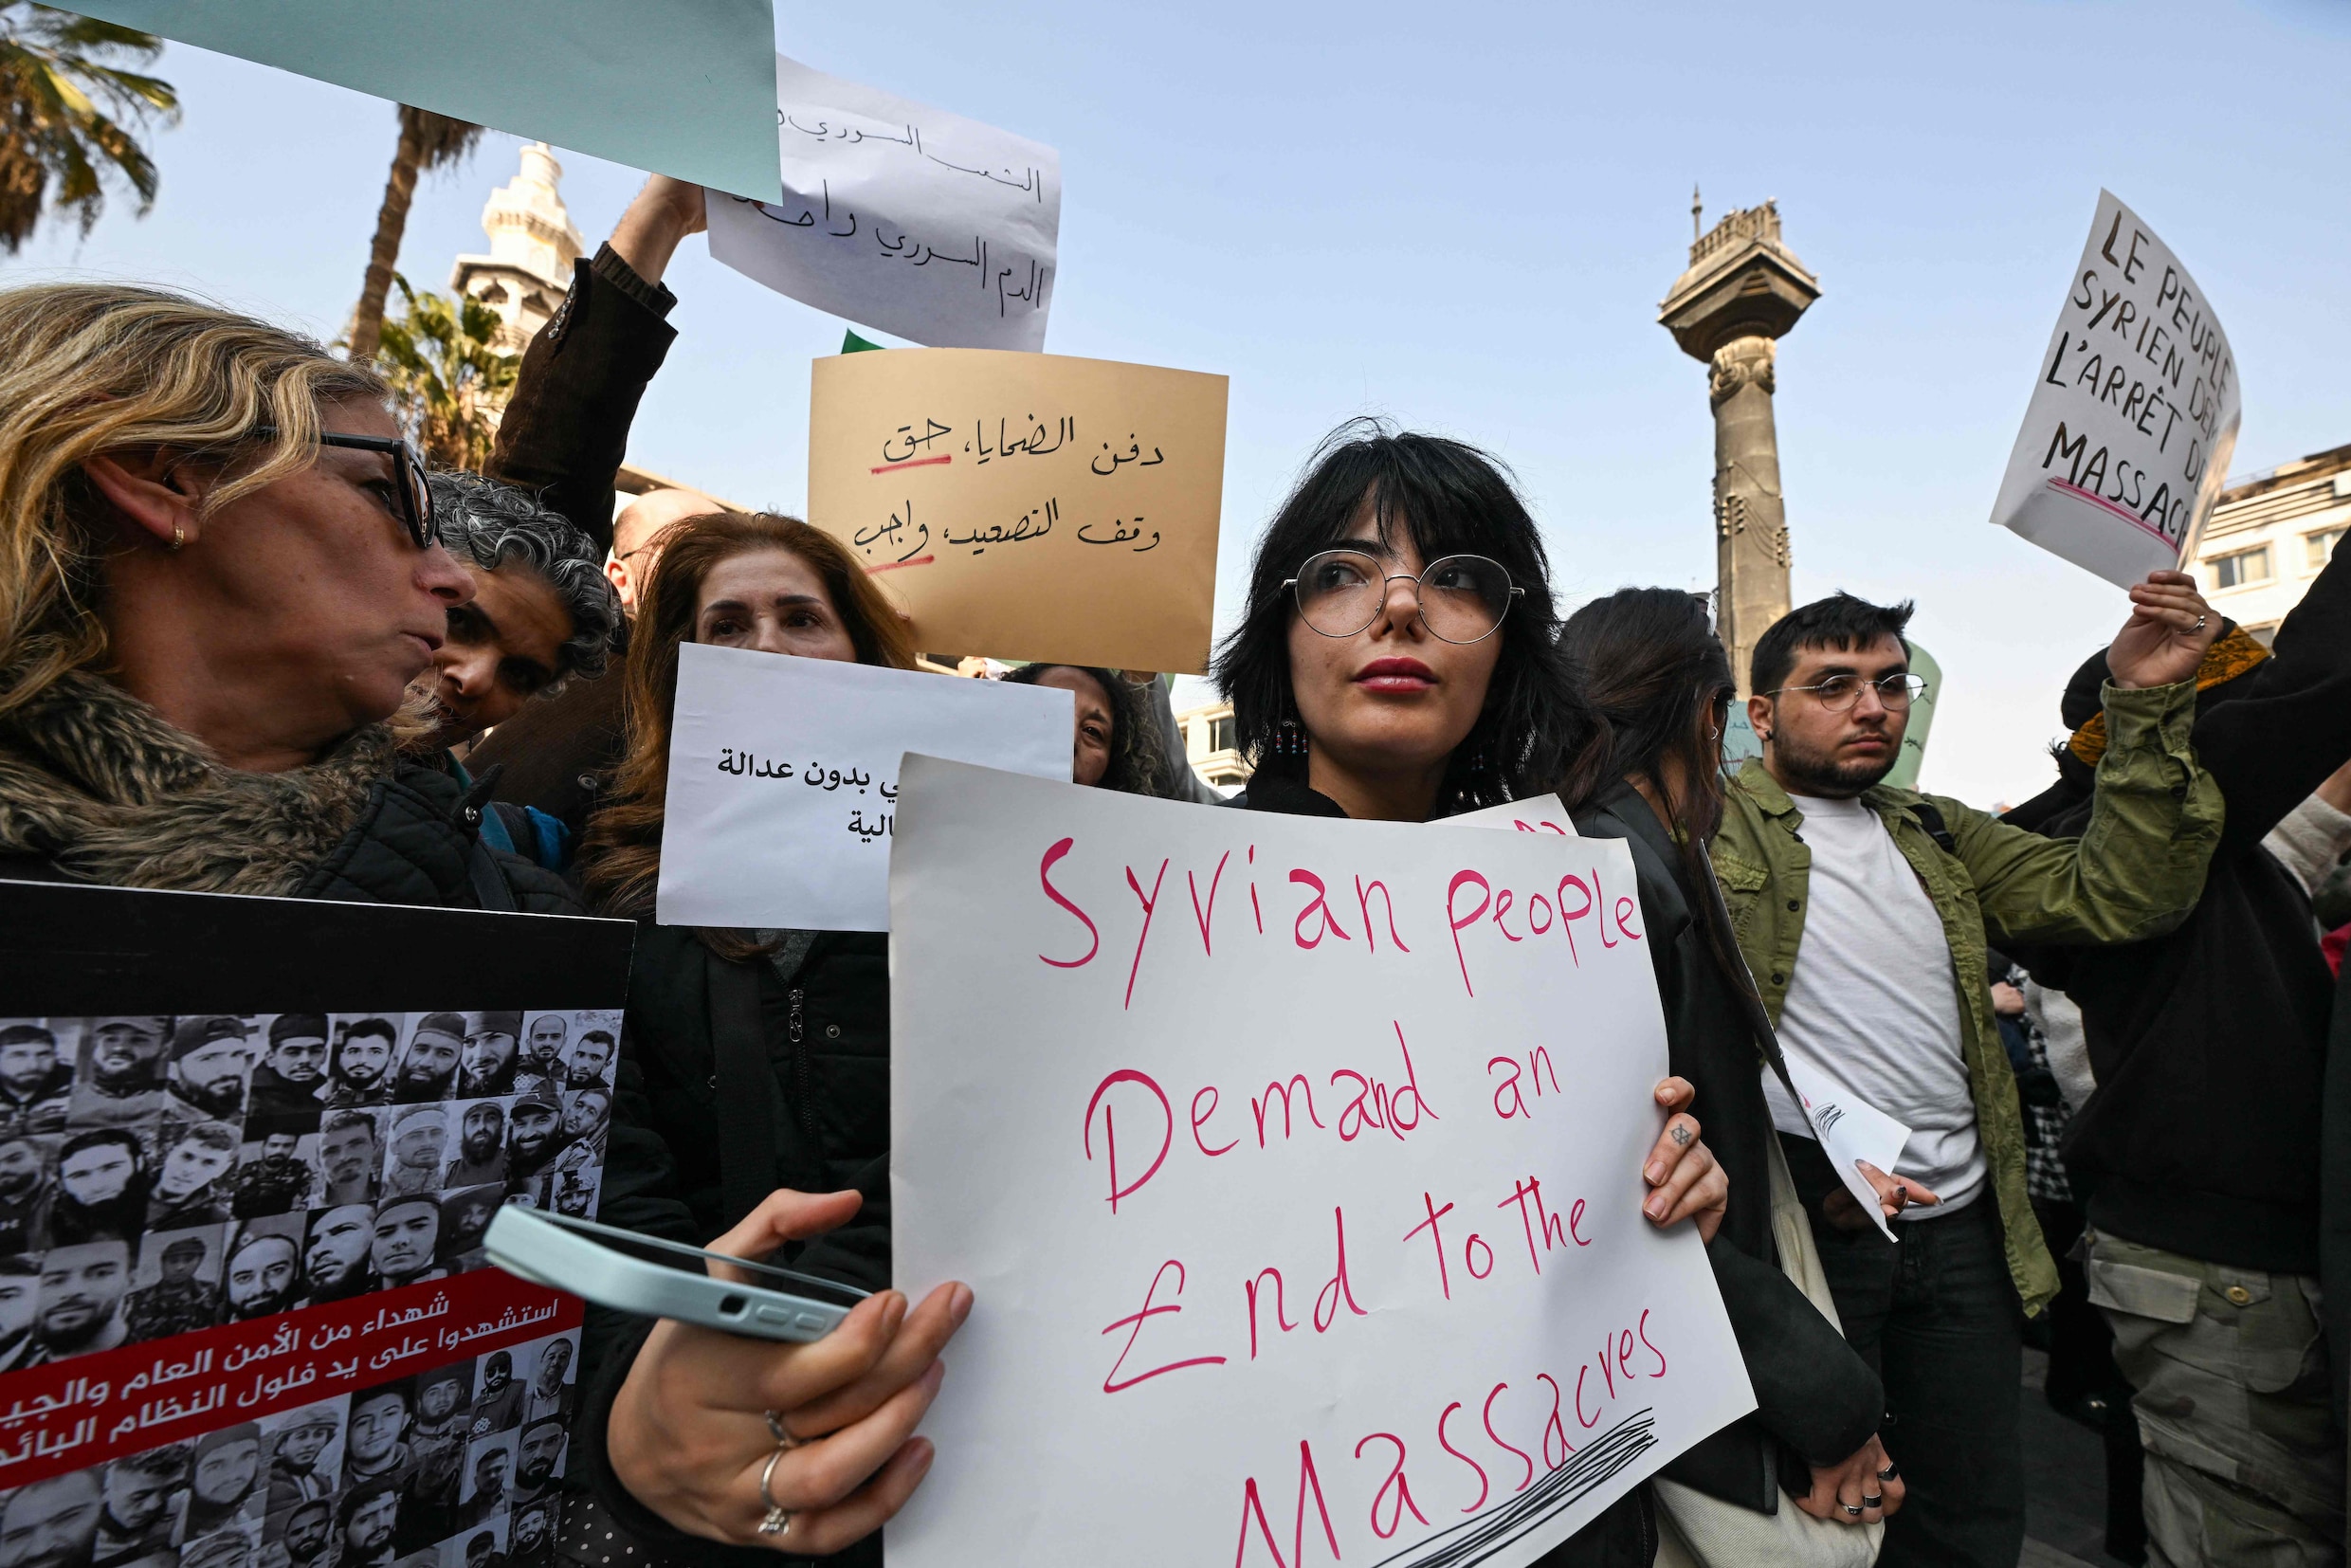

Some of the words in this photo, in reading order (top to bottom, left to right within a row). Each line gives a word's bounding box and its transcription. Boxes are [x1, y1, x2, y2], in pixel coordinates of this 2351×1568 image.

[788, 115, 923, 155] السوري
[927, 155, 1042, 204] الشعب
[731, 177, 857, 238] واح
[875, 227, 988, 290] السوري
[998, 259, 1046, 319] الدم
[2101, 210, 2149, 284] LE
[2156, 264, 2232, 411] PEUPLE
[2072, 269, 2184, 390] SYRIEN
[883, 417, 953, 464] حق
[1090, 432, 1165, 476] دفن
[853, 499, 930, 564] واجب
[1076, 516, 1161, 554] وقف
[717, 747, 795, 779] عدالة
[804, 760, 870, 794] بدون
[1039, 837, 1412, 1010] Syrian
[1084, 1020, 1439, 1214] Demand
[1487, 1046, 1560, 1120] an
[359, 1289, 450, 1338] شهداء
[436, 1297, 559, 1352] استشهدوا
[1102, 1206, 1369, 1395] End
[223, 1321, 302, 1373] الأمن
[309, 1323, 354, 1351] من
[368, 1336, 429, 1371] على
[120, 1347, 215, 1401] العام
[235, 1361, 318, 1409] فلول
[325, 1356, 360, 1380] يد
[0, 1377, 111, 1430] والجي
[108, 1382, 228, 1444] النظام
[1235, 1307, 1668, 1568] Massacres
